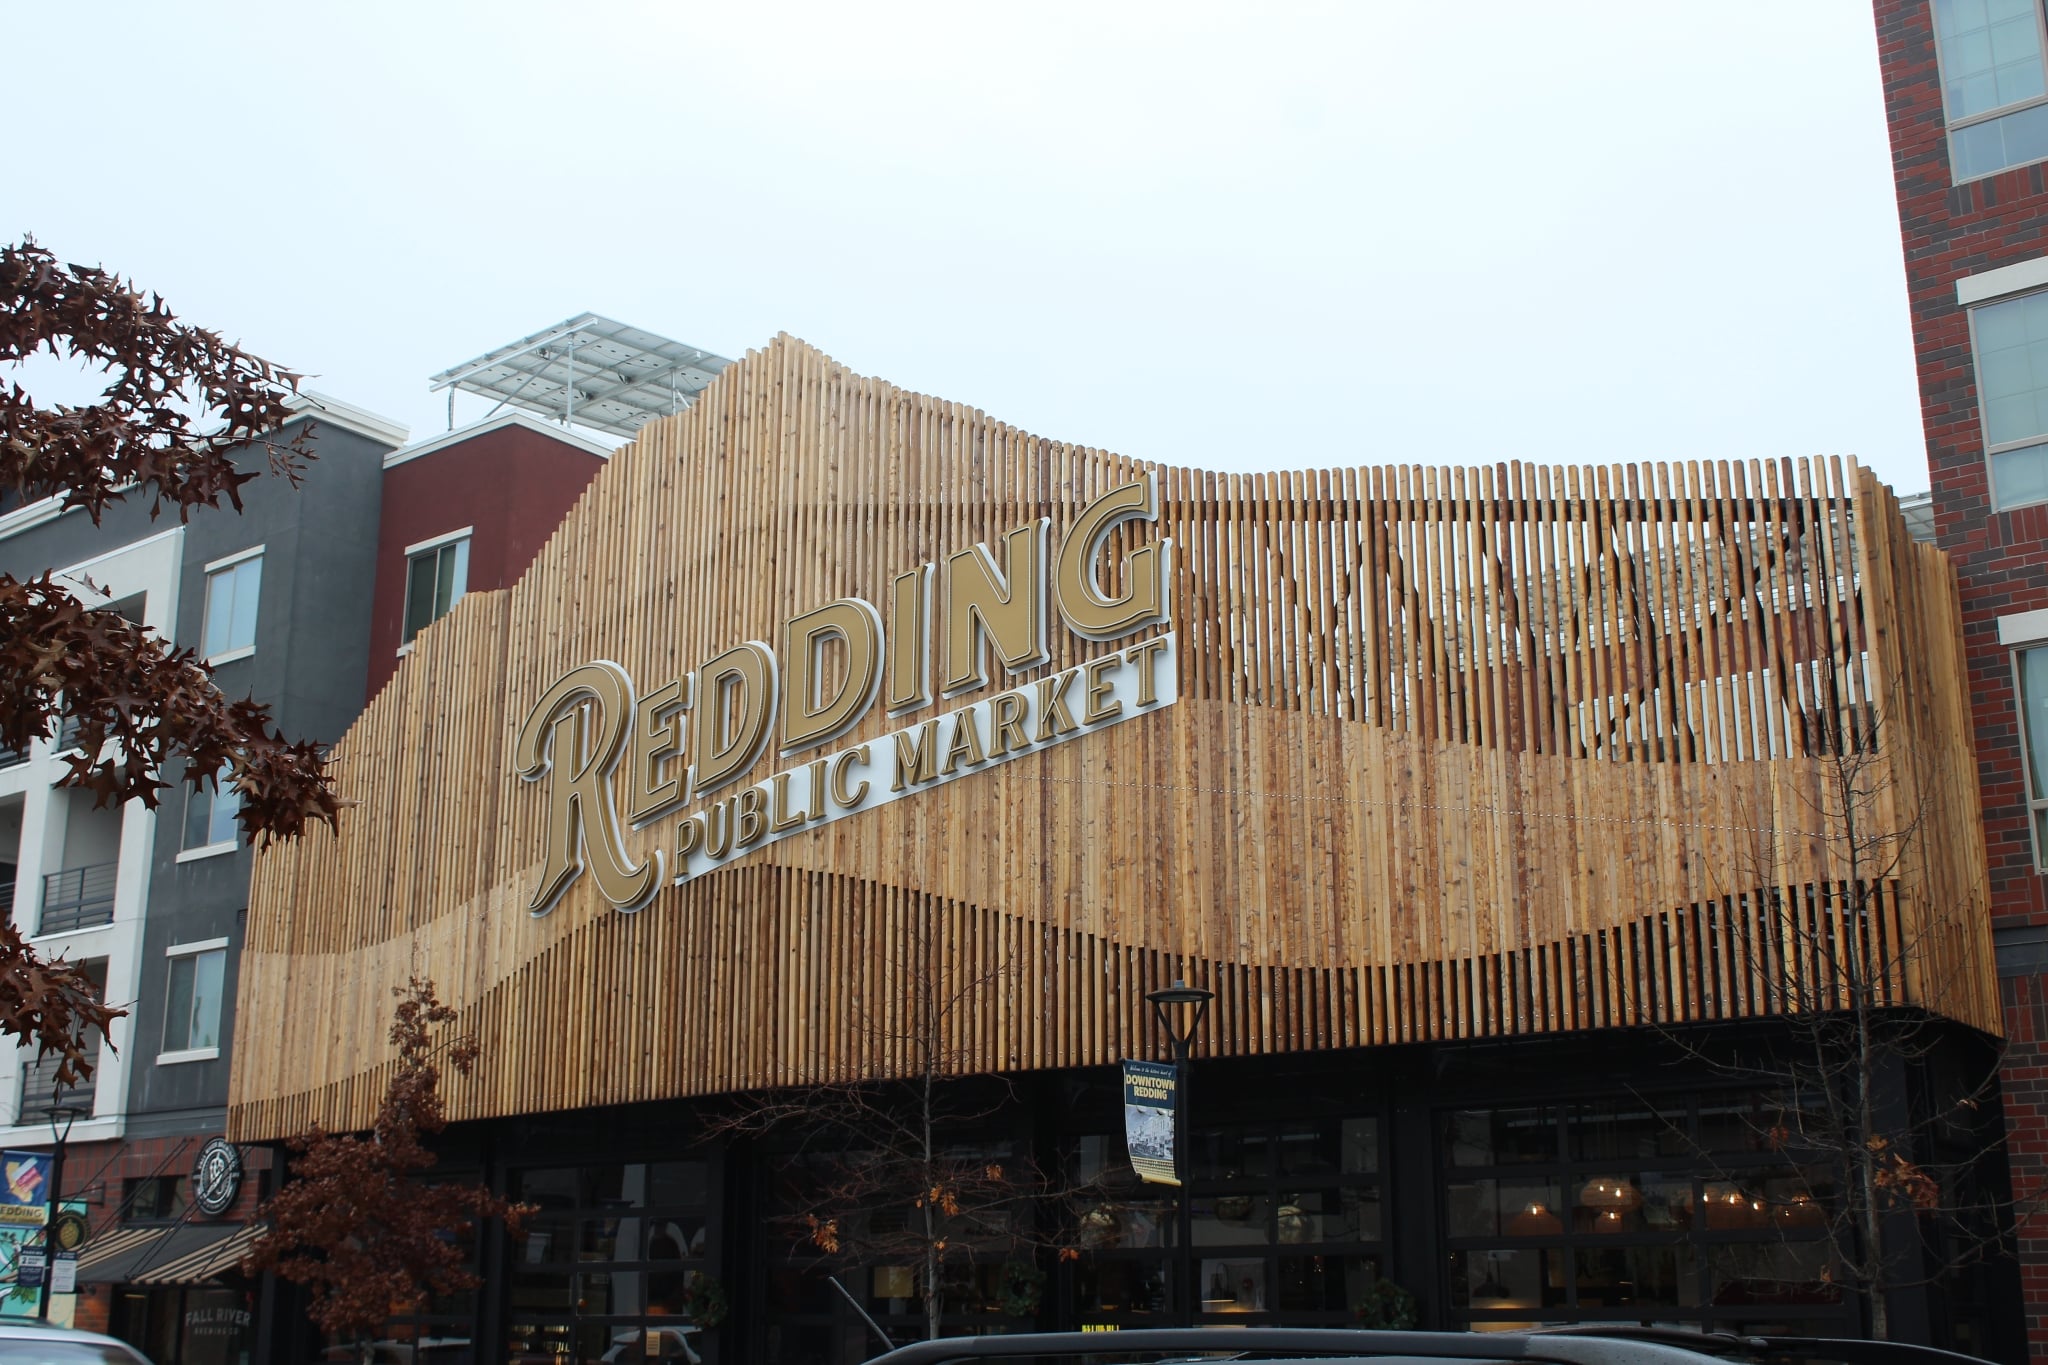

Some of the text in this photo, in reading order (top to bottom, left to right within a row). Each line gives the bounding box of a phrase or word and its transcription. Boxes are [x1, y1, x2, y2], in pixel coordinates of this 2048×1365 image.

[515, 471, 1172, 917] REDDING
[676, 637, 1168, 878] PUBLIC MARKET
[1125, 1074, 1175, 1090] DOWNTOWN
[1133, 1085, 1168, 1100] REDDING
[0, 1205, 43, 1218] EDDING
[185, 1307, 251, 1328] FALL RIVER
